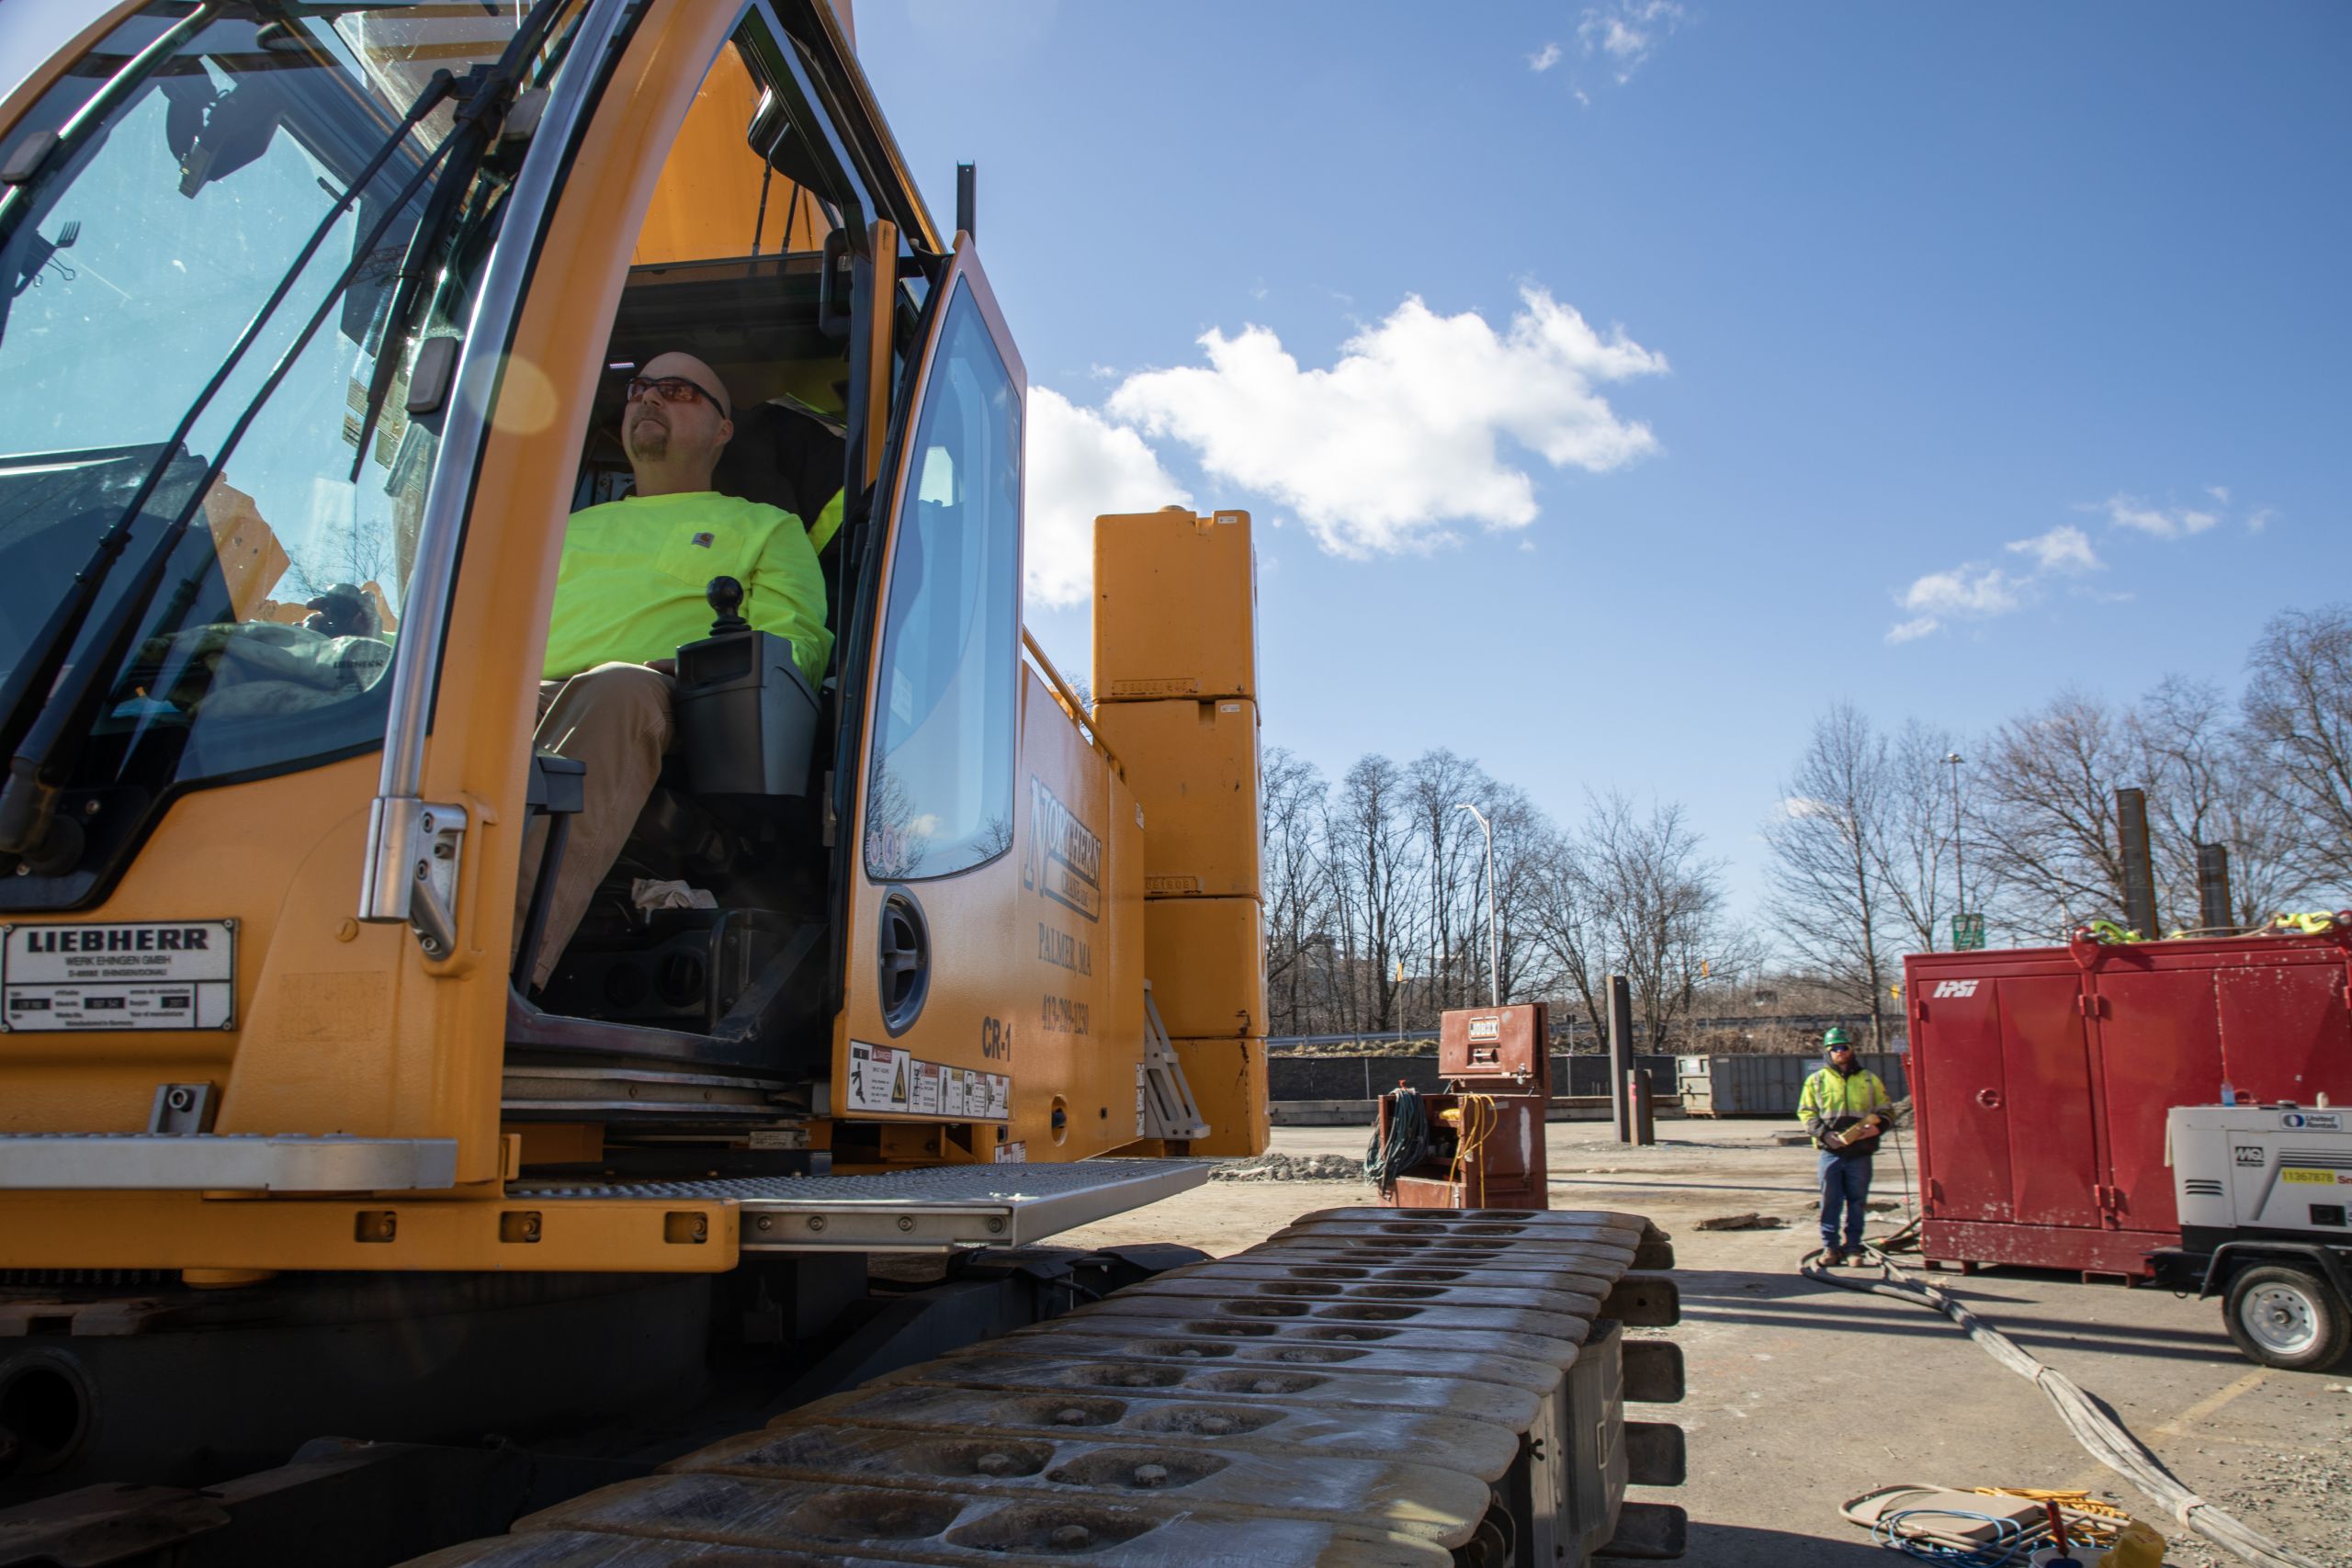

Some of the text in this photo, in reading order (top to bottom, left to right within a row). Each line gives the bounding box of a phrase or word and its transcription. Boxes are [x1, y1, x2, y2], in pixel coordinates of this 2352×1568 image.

[1023, 773, 1102, 898] NORTHERN
[28, 928, 209, 953] LIEBHERR
[1038, 921, 1092, 977] PALMER, MA
[65, 955, 171, 965] WERK EHINGEN GMBH
[982, 1015, 1011, 1063] CR-1
[2234, 1146, 2265, 1162] MQ
